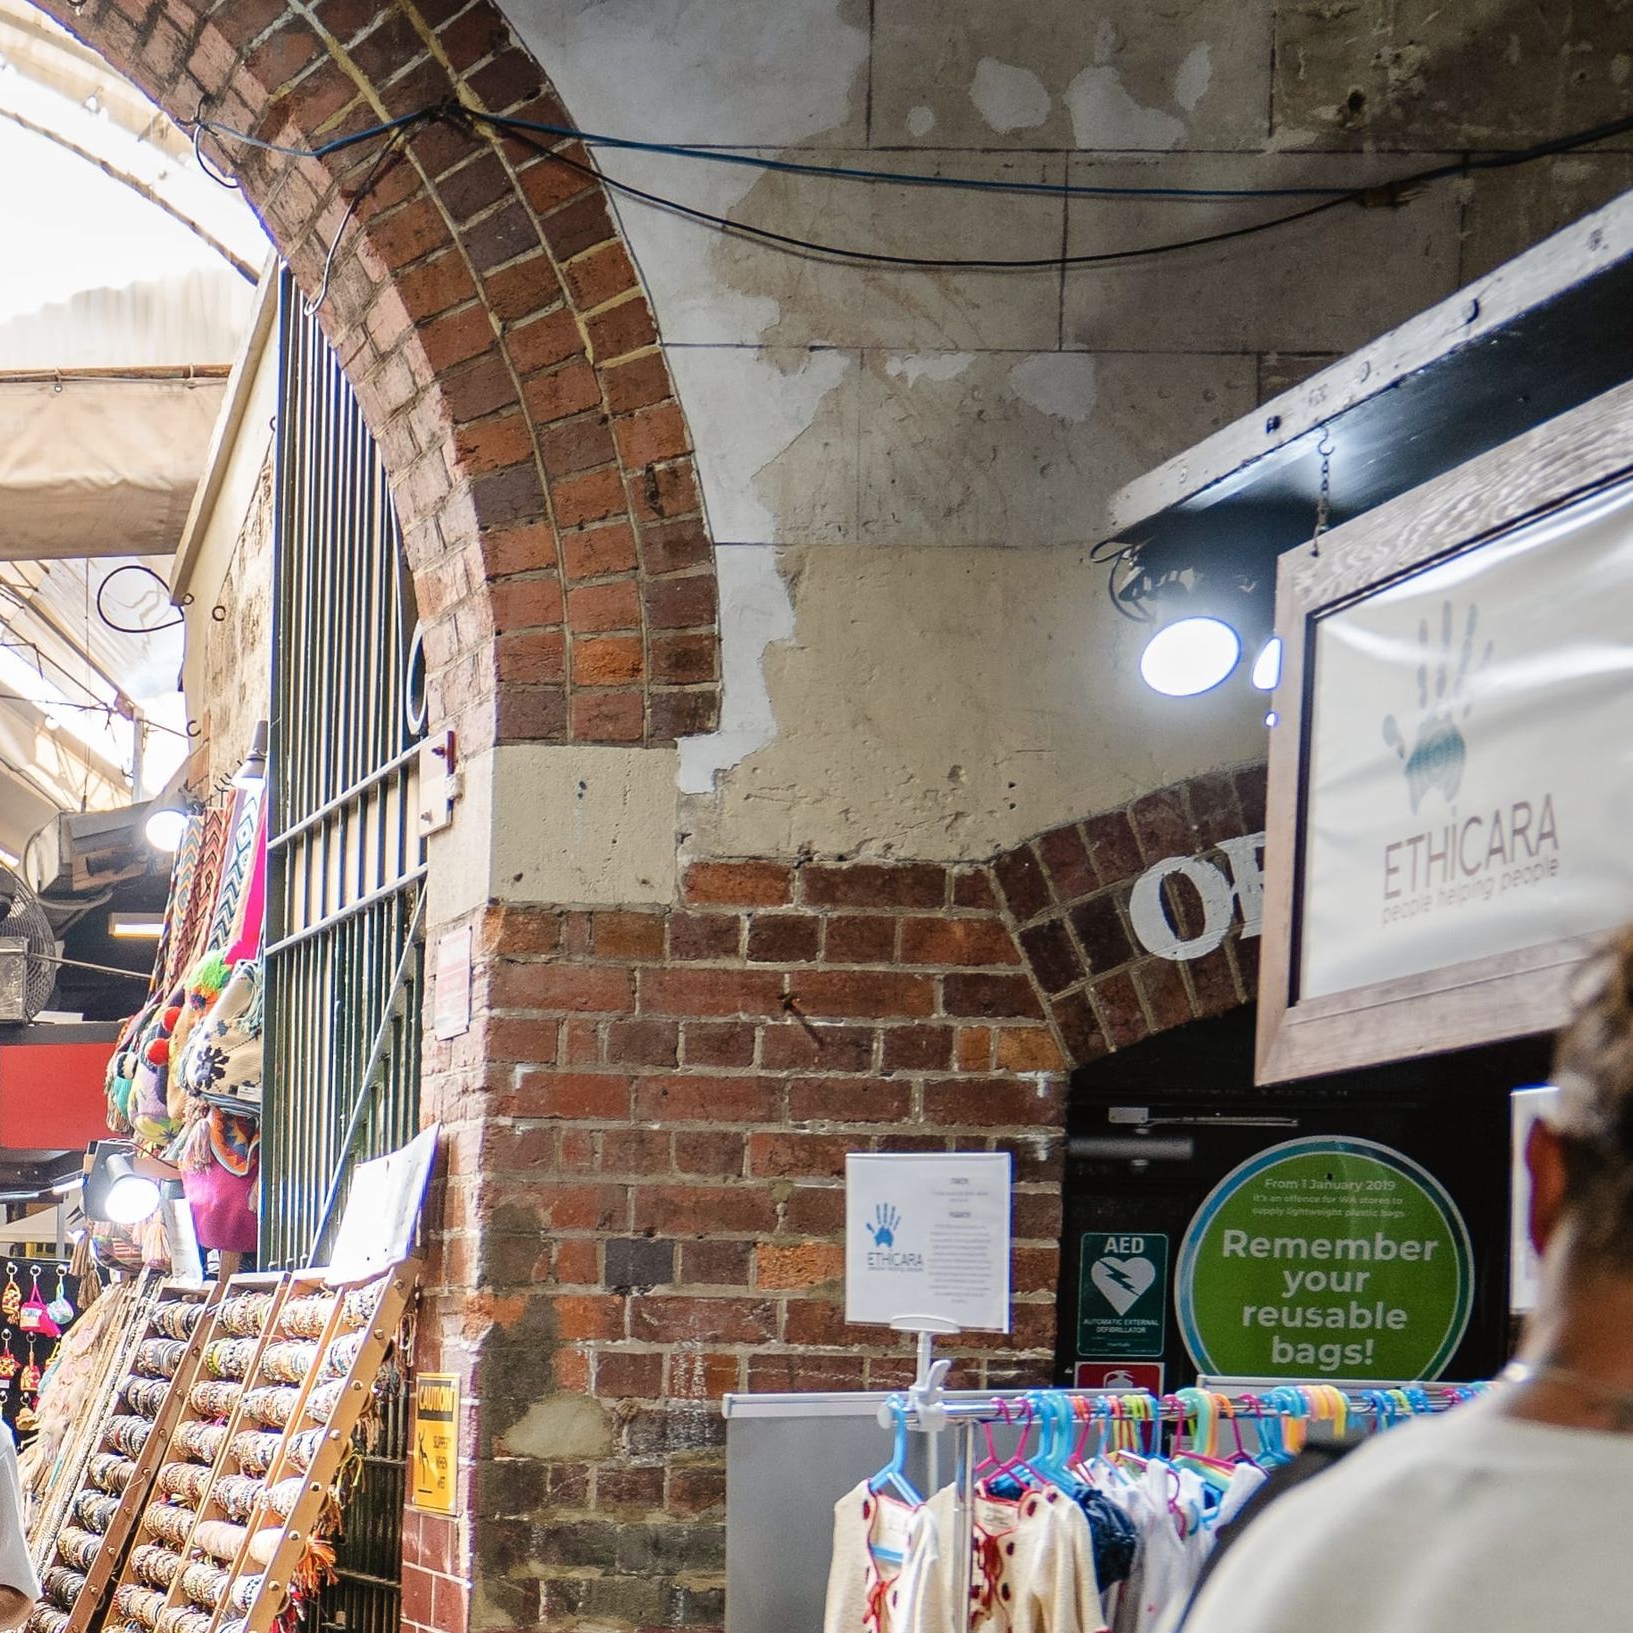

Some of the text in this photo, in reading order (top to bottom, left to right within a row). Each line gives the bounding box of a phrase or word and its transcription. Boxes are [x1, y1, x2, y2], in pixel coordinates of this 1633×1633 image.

[1382, 891, 1435, 925] people
[1500, 857, 1560, 897] people
[1264, 1179, 1298, 1190] From
[1308, 1180, 1363, 1193] January
[1366, 1181, 1396, 1191] 2019
[867, 1251, 924, 1267] ETHICARA
[1104, 1237, 1145, 1254] AED
[1223, 1229, 1439, 1262] Remember
[1281, 1270, 1370, 1298] your
[1084, 1318, 1160, 1326] AUTOMATIC EXTERNAL
[1242, 1301, 1408, 1330] reusable
[1096, 1326, 1147, 1334] DEFIBRILLATOR
[1271, 1335, 1375, 1372] bags!
[419, 1384, 453, 1412] CAUTION
